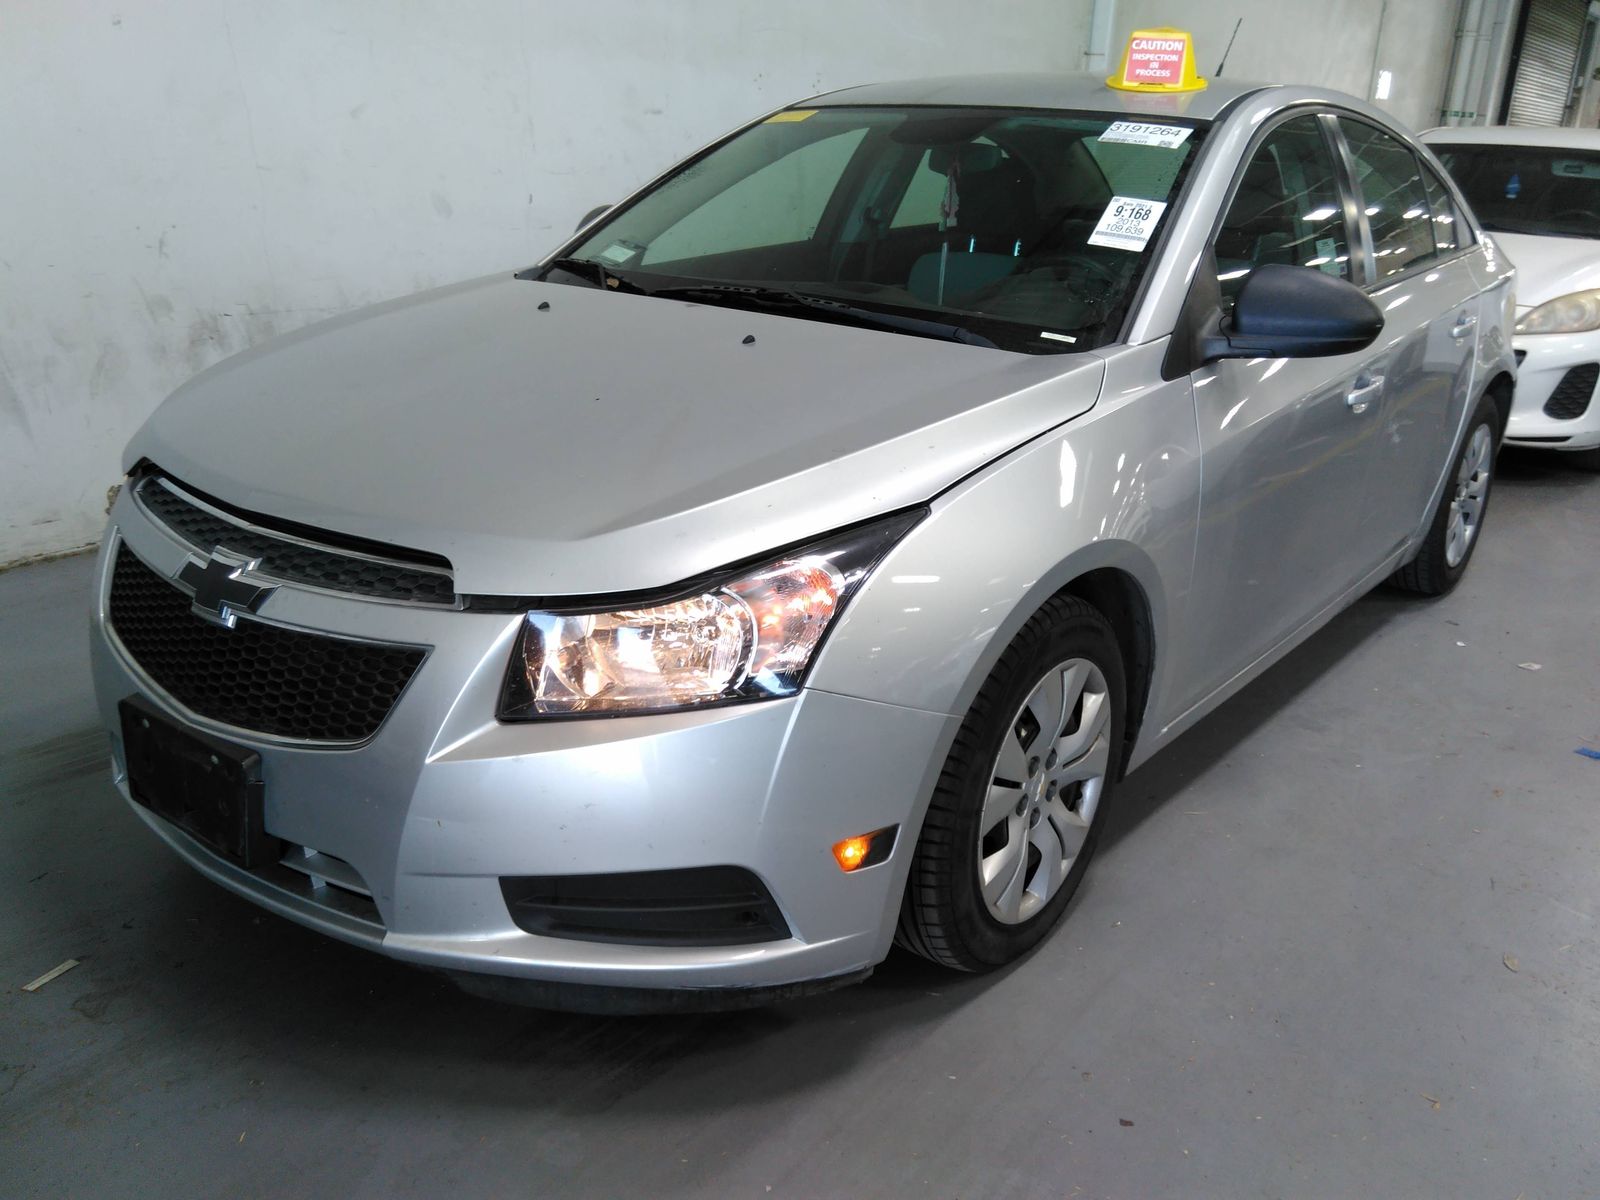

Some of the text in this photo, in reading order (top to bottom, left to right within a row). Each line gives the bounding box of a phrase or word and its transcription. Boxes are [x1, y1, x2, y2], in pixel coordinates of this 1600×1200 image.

[1132, 40, 1183, 51] CAUTION
[1132, 53, 1179, 62] INSPECTION
[1150, 61, 1160, 69] IN
[1135, 68, 1171, 77] PROCESS
[1110, 123, 1182, 137] 3191264
[1113, 205, 1152, 221] 9:168
[1116, 217, 1141, 227] 2013
